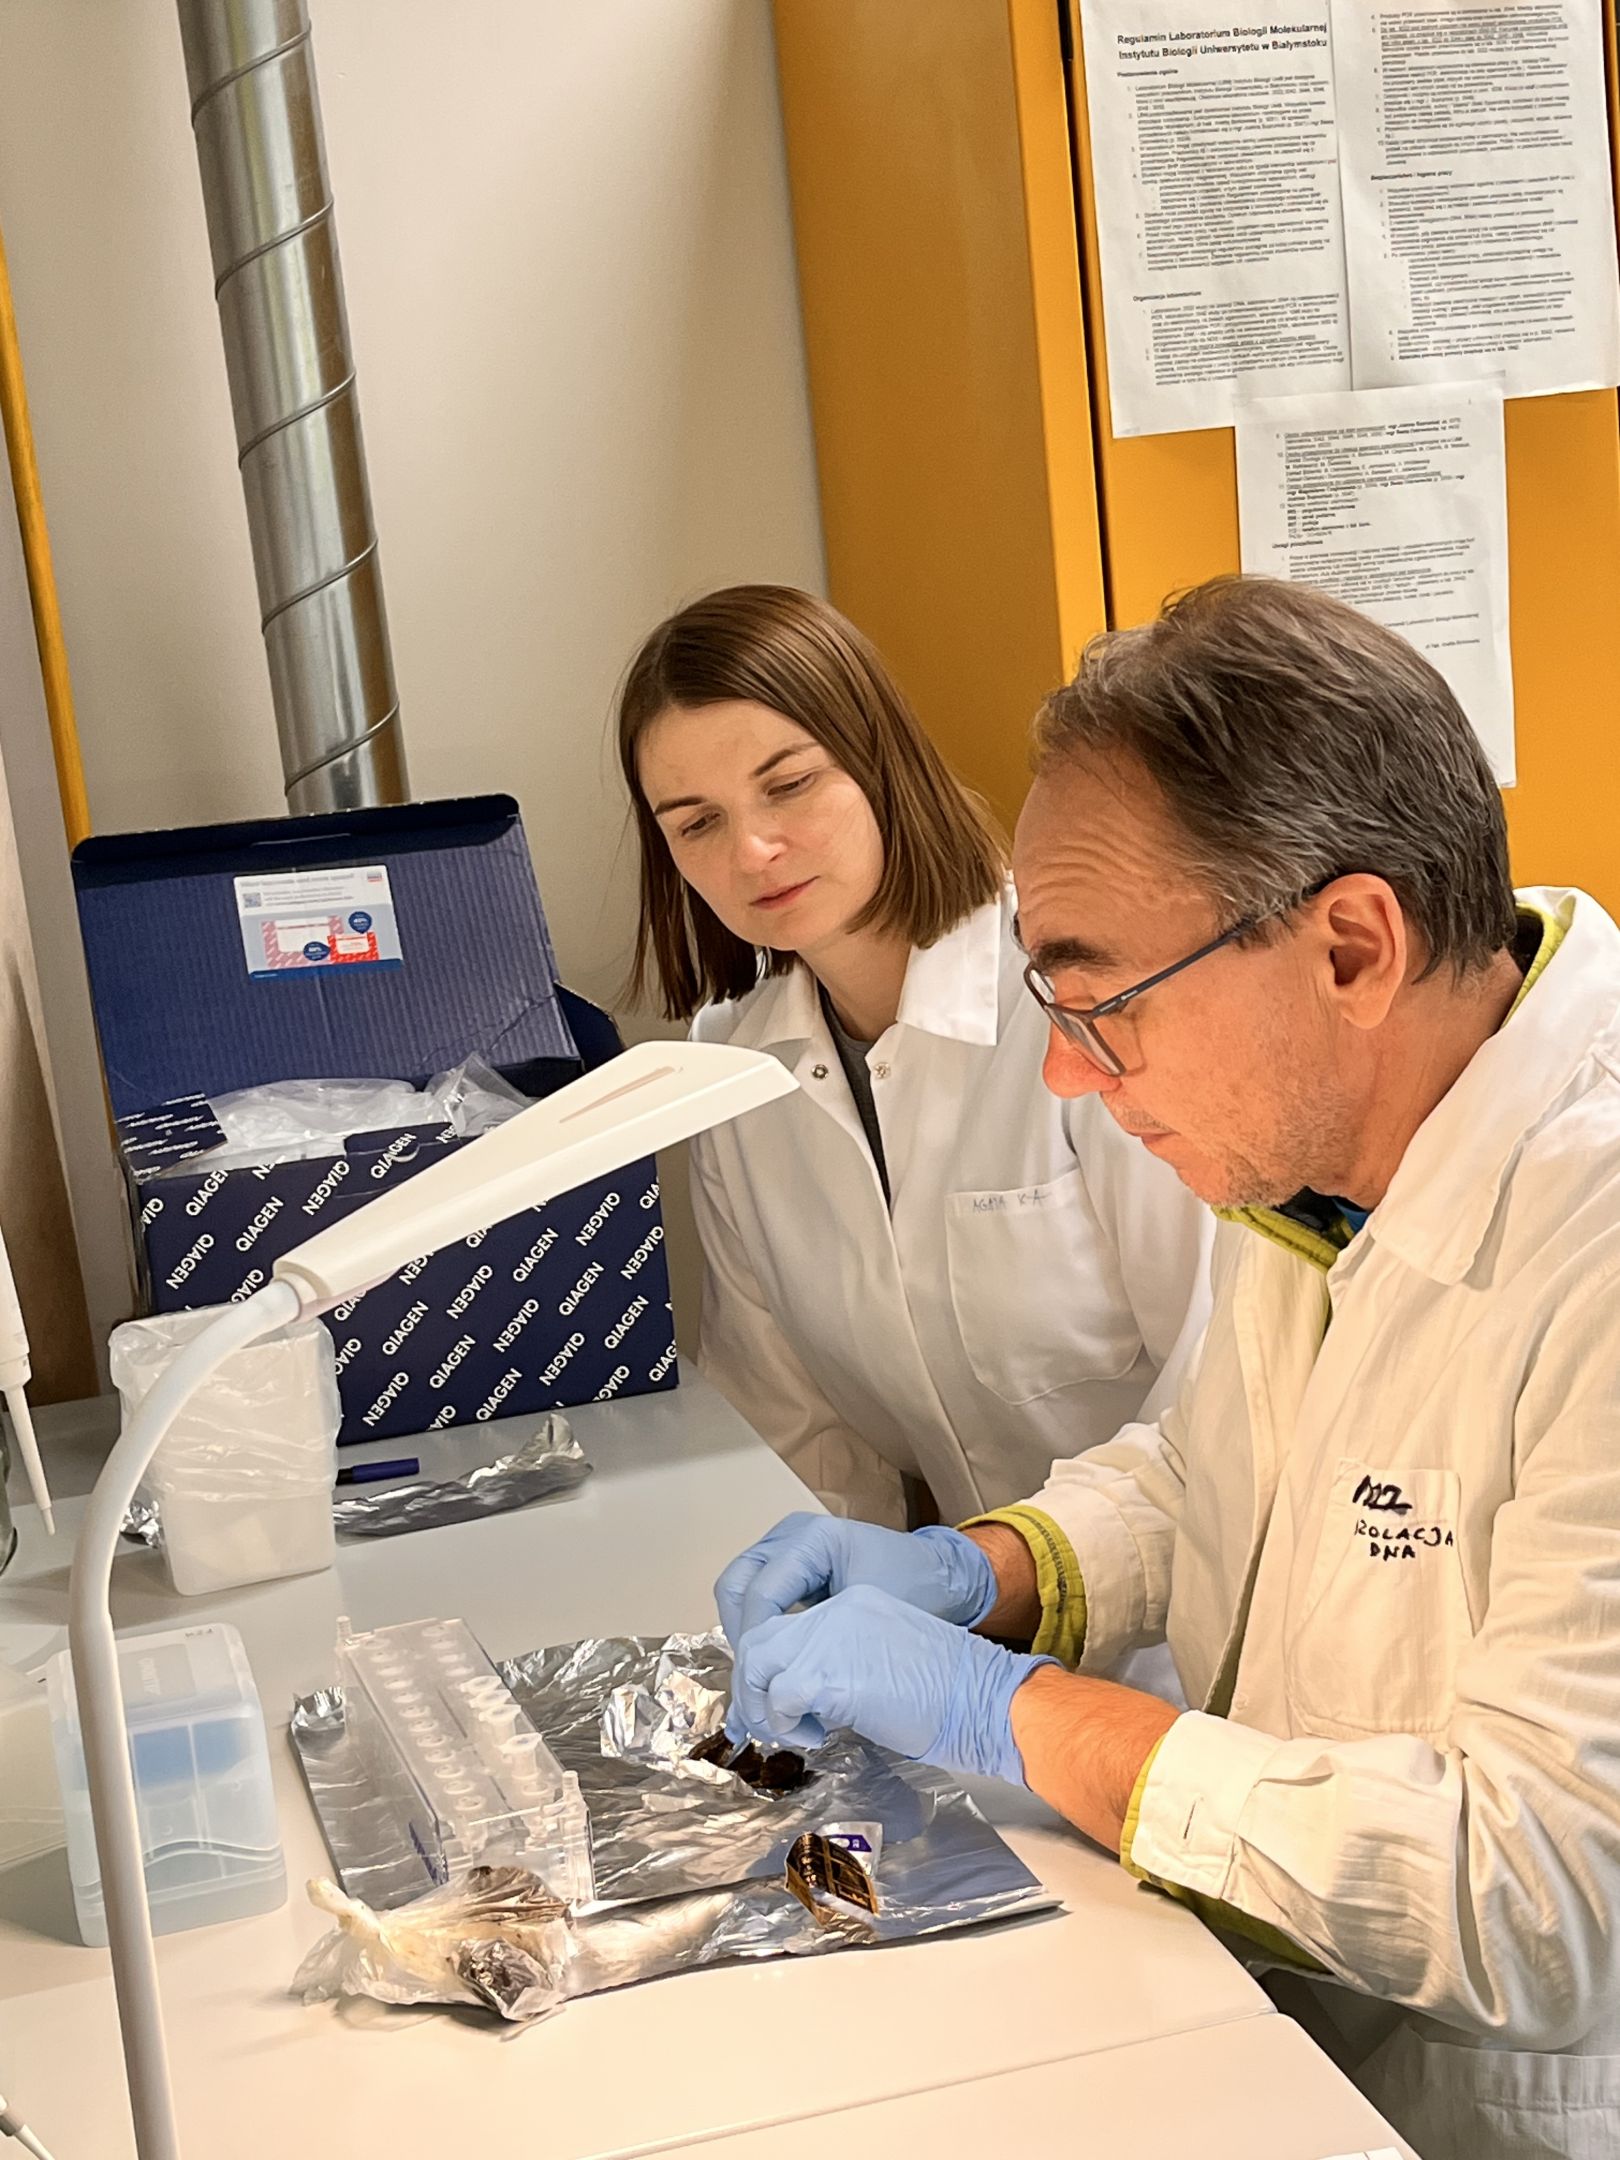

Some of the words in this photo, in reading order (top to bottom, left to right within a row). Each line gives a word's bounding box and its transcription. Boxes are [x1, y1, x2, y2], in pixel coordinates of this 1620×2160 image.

[1117, 33, 1167, 45] Regulamin
[1168, 29, 1231, 41] Laboratorium
[1232, 26, 1268, 37] Biologii
[1269, 23, 1327, 34] Molekularnej
[1118, 49, 1160, 60] Instytutu
[1161, 46, 1198, 57] Biologii
[1199, 42, 1260, 54] Uniwersytetu
[1271, 38, 1328, 51] Białymstoku
[370, 1132, 417, 1179] QIAGEN
[301, 1160, 350, 1216] QIAGEN
[235, 1196, 284, 1251] QIAGEN
[575, 1192, 620, 1247] QIAGEN
[165, 1233, 214, 1289] QIAGEN
[399, 1251, 434, 1286] GEN
[512, 1227, 559, 1282] QIAGEN
[620, 1226, 664, 1280] QIAGEN
[446, 1265, 493, 1319] QIAGEN
[558, 1261, 605, 1316] QIAGEN
[382, 1300, 429, 1355] QIAGEN
[493, 1299, 539, 1353] QIAGEN
[604, 1295, 649, 1349] QIAGEN
[429, 1334, 476, 1389] QIAGEN
[539, 1332, 585, 1386] QIAGEN
[592, 1365, 630, 1402] QIAG
[648, 1340, 677, 1382] QIAG
[362, 1372, 409, 1427] QIAGEN
[475, 1368, 523, 1421] QIAGEN
[1370, 1541, 1416, 1561] DNA
